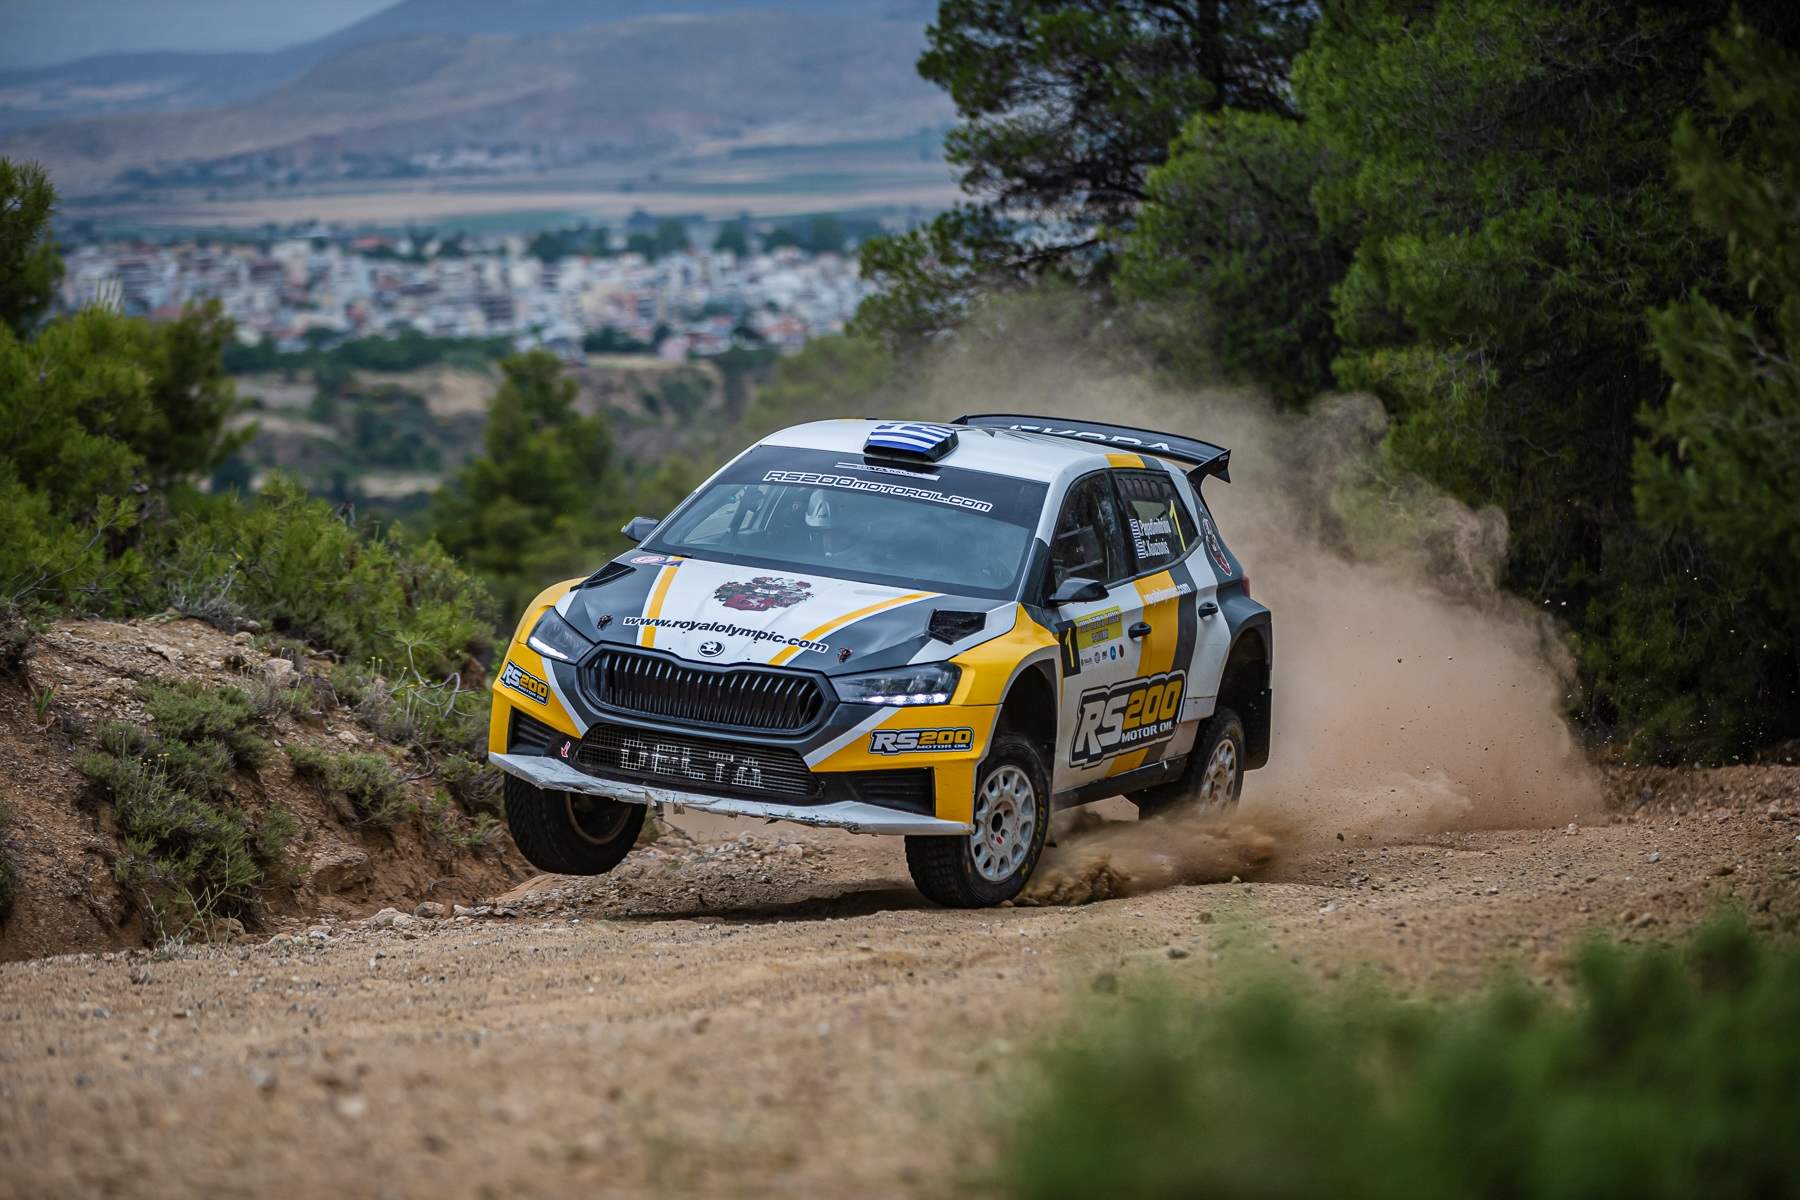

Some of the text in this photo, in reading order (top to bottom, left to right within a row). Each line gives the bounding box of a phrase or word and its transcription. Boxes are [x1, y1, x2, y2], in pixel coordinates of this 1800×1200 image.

[1169, 500, 1187, 551] 1
[623, 616, 829, 654] www.royalolympic.com
[1064, 627, 1075, 668] 1
[501, 662, 548, 698] RS200
[1074, 680, 1183, 755] RS200
[1121, 720, 1173, 743] MOTOR OIL
[872, 730, 972, 752] RS200
[620, 738, 765, 789] DELTA
